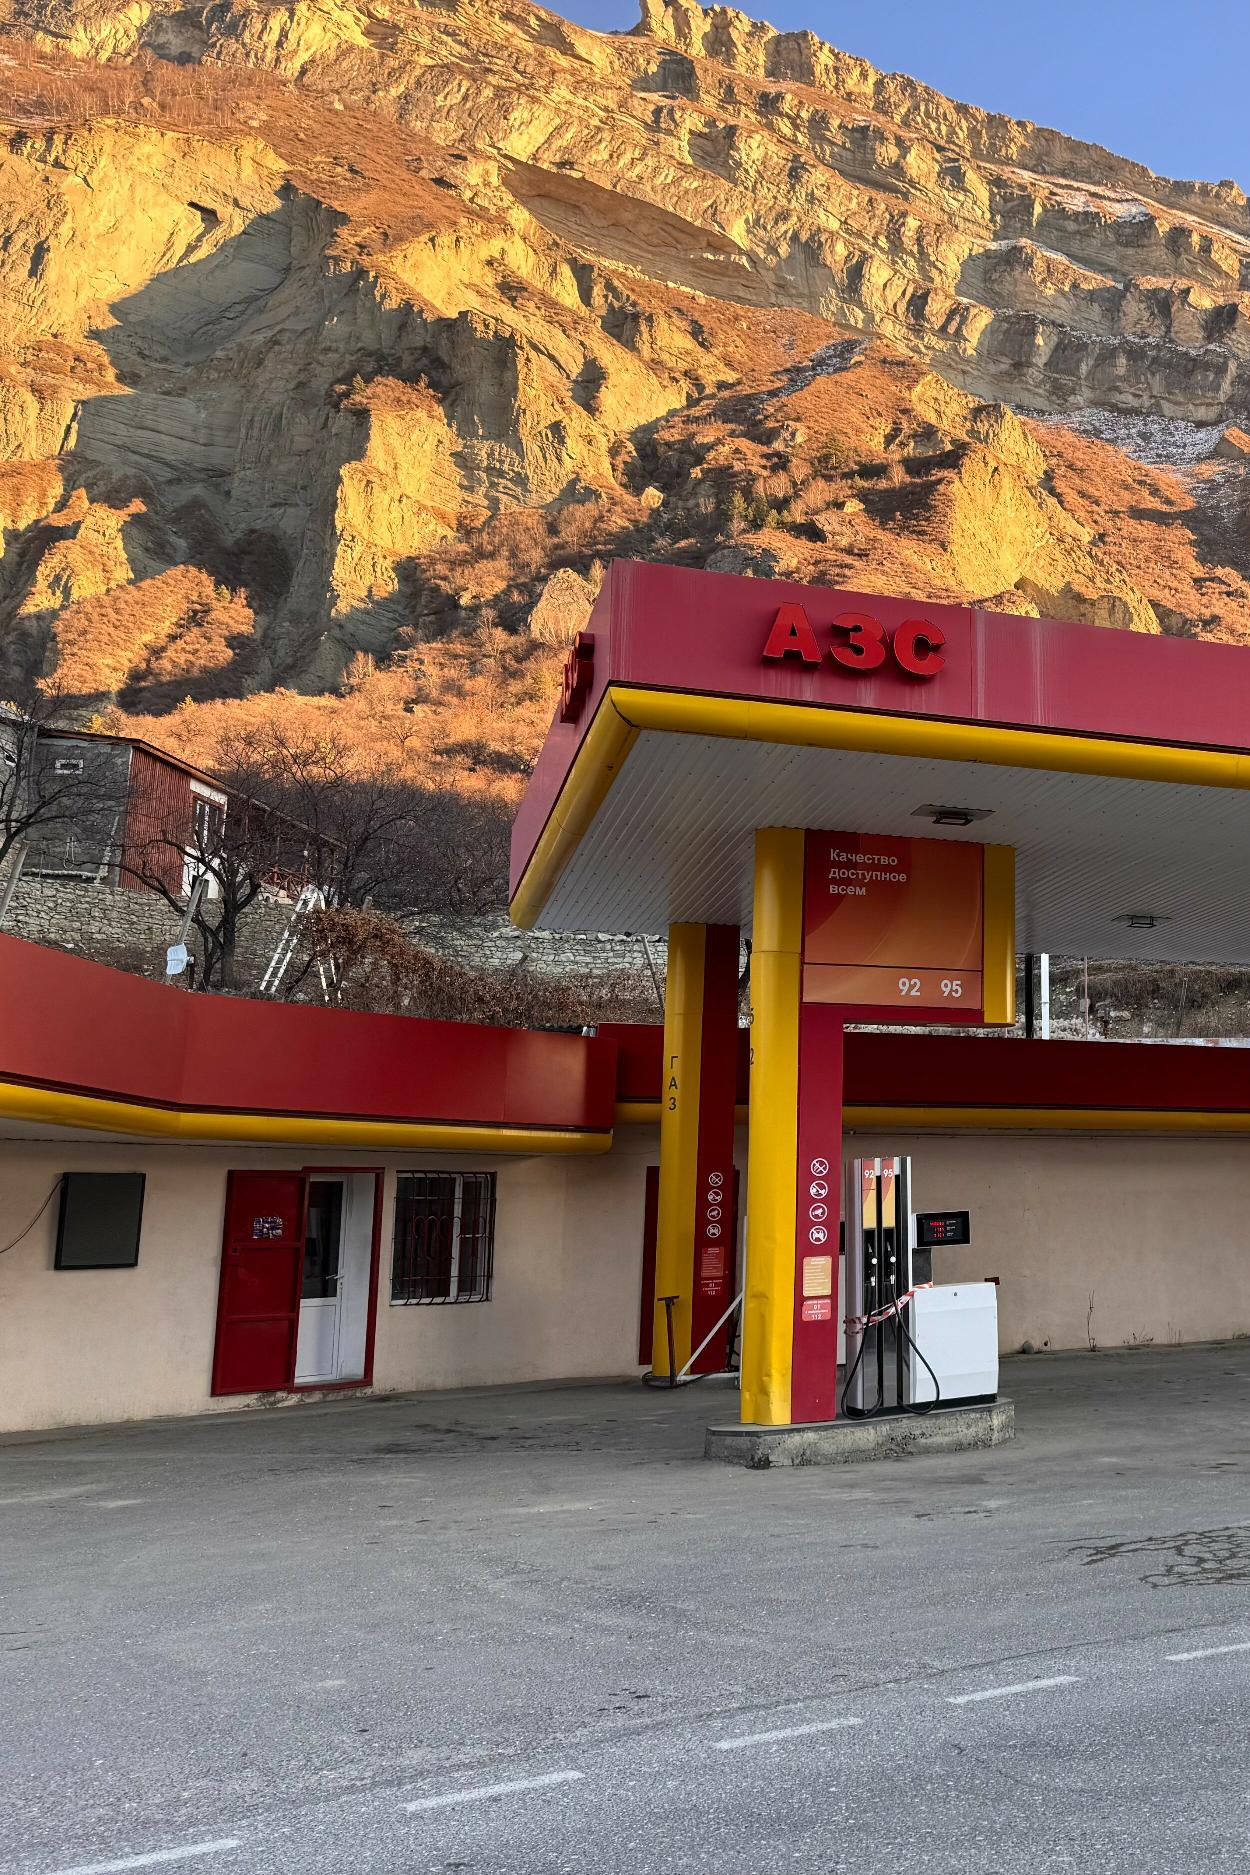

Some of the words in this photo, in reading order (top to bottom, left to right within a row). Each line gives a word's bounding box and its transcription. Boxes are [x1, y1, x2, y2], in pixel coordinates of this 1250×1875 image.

[762, 602, 946, 677] АЗС
[830, 848, 898, 865] Качество
[828, 868, 907, 882] доступное
[829, 884, 866, 895] всем
[898, 978, 921, 996] 92
[940, 979, 963, 998] 95
[864, 1169, 875, 1179] 92
[883, 1168, 894, 1179] 95
